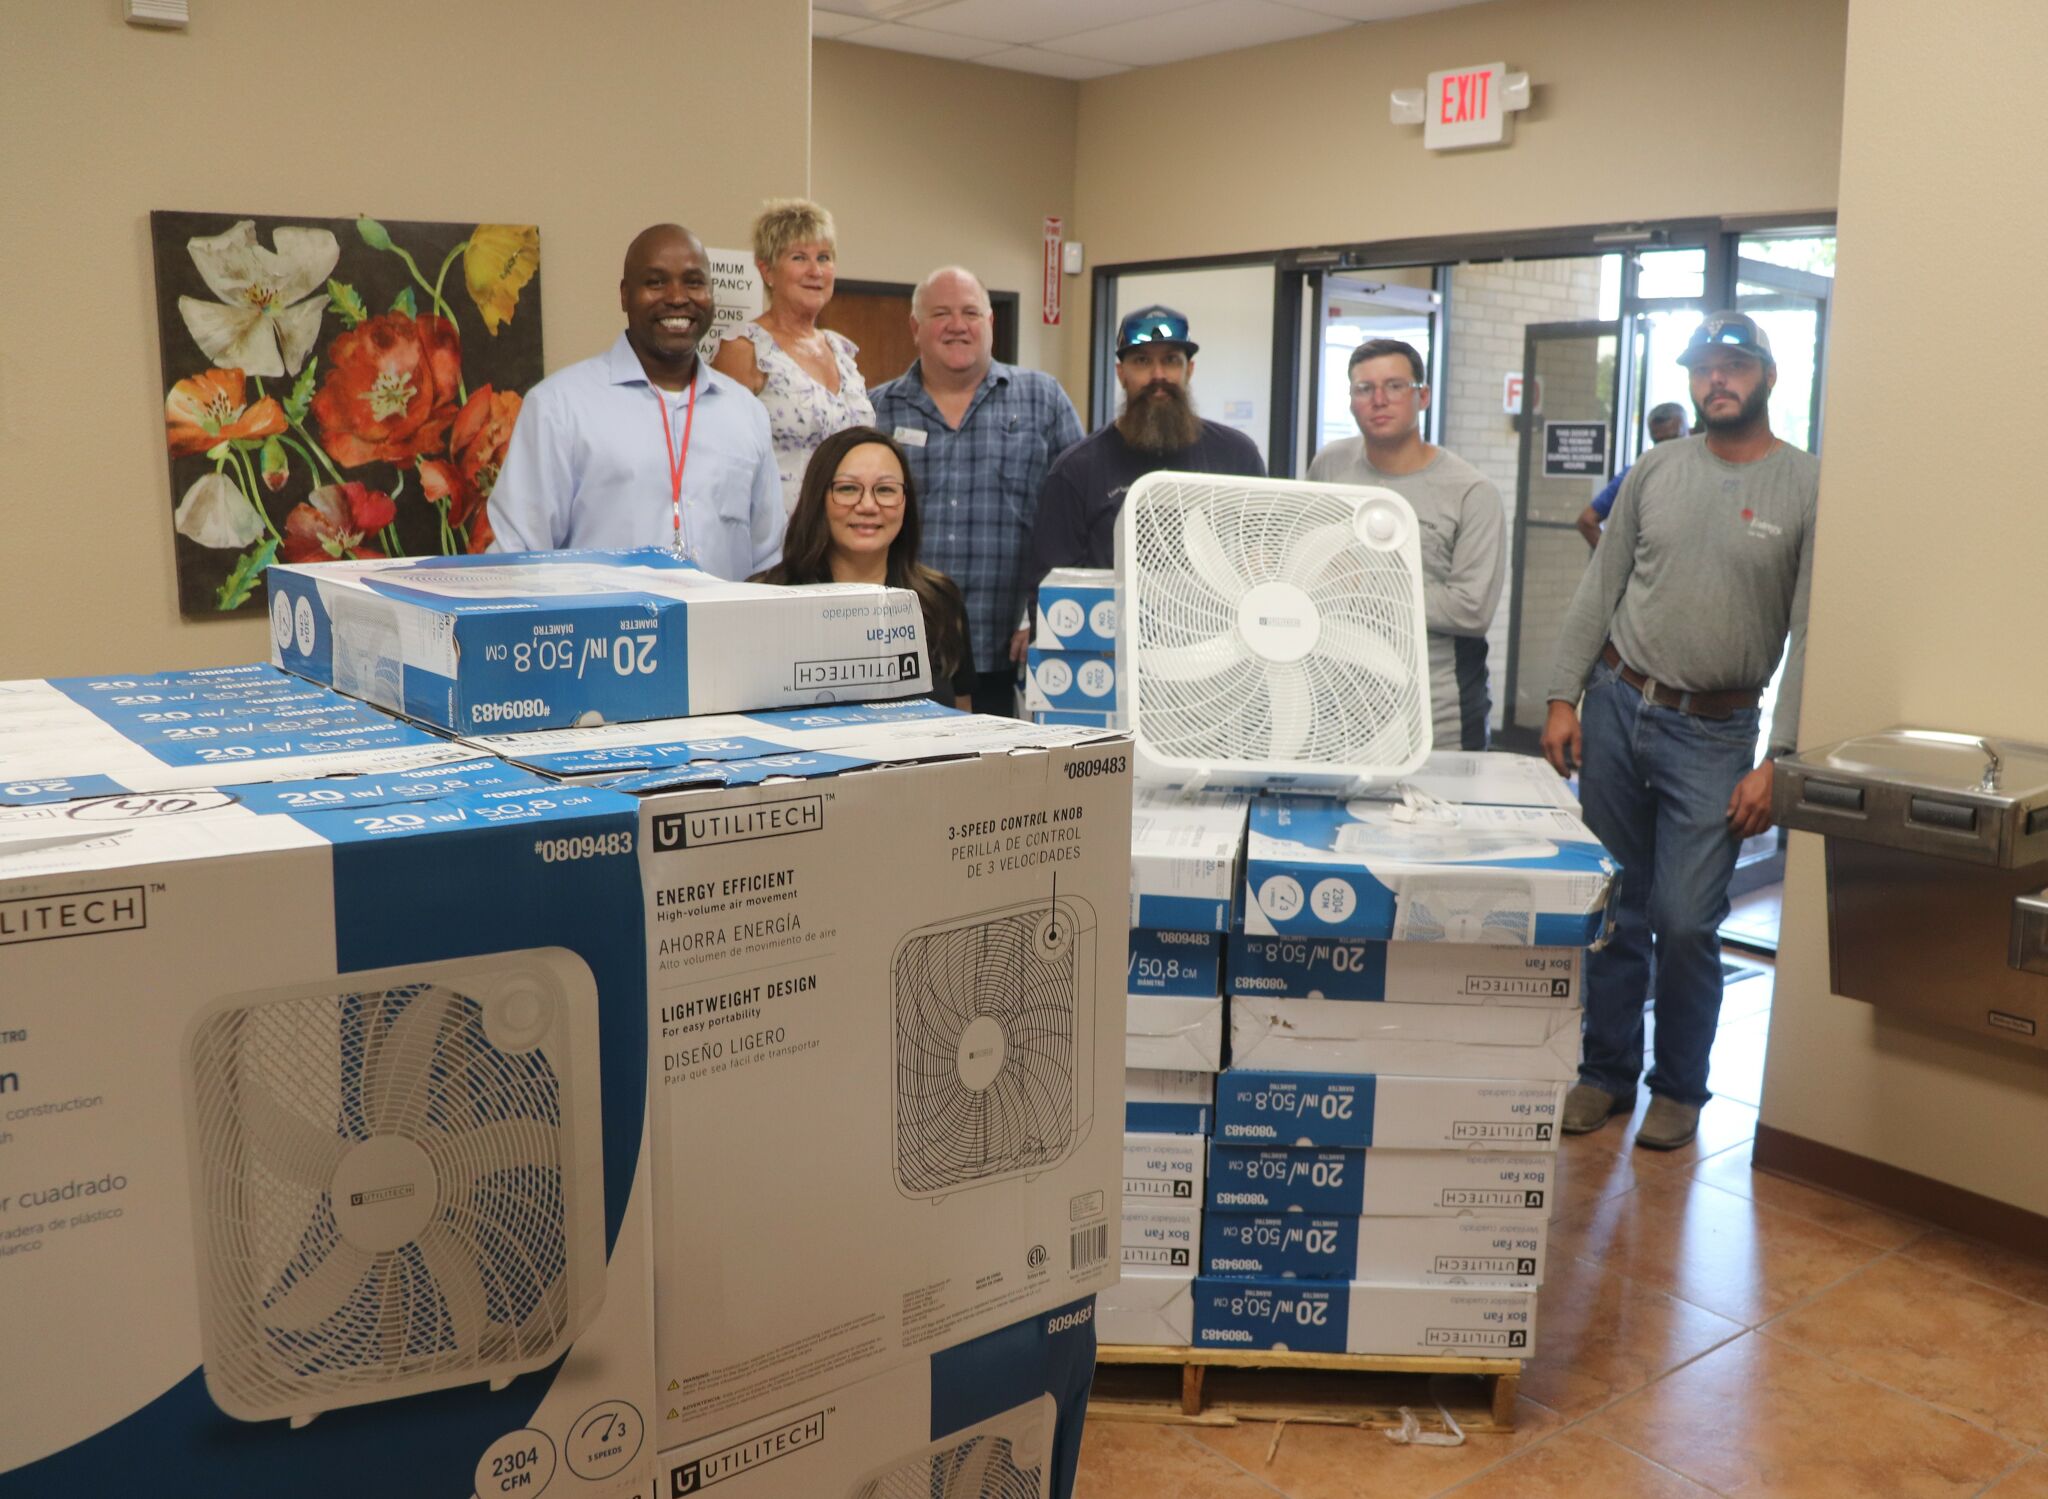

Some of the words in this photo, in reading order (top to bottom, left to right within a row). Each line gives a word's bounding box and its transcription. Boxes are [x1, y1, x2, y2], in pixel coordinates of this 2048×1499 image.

[1441, 71, 1493, 125] EXIT
[712, 262, 744, 275] IMUM
[711, 278, 752, 291] PANCY
[822, 607, 869, 619] cuadrado
[533, 624, 574, 636] DIÁMETRO
[620, 620, 658, 631] DIAMETER
[892, 625, 916, 640] Box
[867, 627, 891, 644] Fan
[485, 645, 507, 661] CM
[513, 637, 574, 673] 50,8
[612, 635, 658, 676] 20
[801, 663, 897, 683] UTILITECH
[88, 681, 137, 690] 20
[112, 694, 162, 704] 20
[137, 711, 192, 722] 20
[472, 698, 551, 723] #0809483
[162, 726, 219, 738] 20
[311, 723, 397, 737] #0809483
[196, 746, 256, 759] 20
[688, 741, 743, 753] 20
[401, 762, 494, 779] #0809483
[1064, 756, 1126, 779] #0809483
[4, 782, 75, 797] 20
[278, 789, 346, 806] 20
[475, 777, 502, 786] CM
[354, 814, 425, 831] 20
[474, 799, 558, 819] 50,8
[562, 795, 593, 807] CM
[691, 804, 817, 838] UTILITECH
[948, 820, 996, 840] 3-SPEED
[1001, 811, 1048, 831] CONTROL
[1053, 806, 1083, 822] KNOB
[535, 831, 632, 863] #0809483
[952, 840, 1000, 861] PERILLA
[1006, 836, 1020, 851] DE
[1026, 827, 1081, 847] CONTROL
[967, 864, 982, 879] DE
[987, 861, 995, 874] 3
[1000, 846, 1081, 872] VELOCIDADES
[656, 883, 716, 907] ENERGY
[722, 869, 795, 896] EFFICIENT
[657, 902, 726, 923] High-volume
[729, 899, 742, 910] air
[746, 889, 798, 907] movement
[1321, 891, 1330, 909] CFM
[1333, 888, 1344, 914] 2304
[0, 898, 134, 934] LITECH
[659, 928, 727, 956] AHORRA
[734, 913, 801, 942] ENERGÍA
[1156, 931, 1210, 946] #0809483
[659, 959, 680, 971] Alto
[684, 951, 727, 966] volumen
[730, 946, 742, 956] de
[745, 935, 802, 953] movimiento
[805, 931, 816, 942] de
[819, 928, 837, 939] aire
[1247, 943, 1262, 953] CM
[1265, 942, 1306, 963] 50,8
[1333, 947, 1366, 972] 20
[1525, 958, 1545, 971] Fan
[1550, 959, 1571, 971] Box
[1138, 958, 1180, 980] 50,8
[1182, 967, 1198, 979] CM
[1235, 976, 1288, 991] #0809483
[1470, 980, 1549, 993] UTILITECH
[661, 987, 761, 1023] LIGHTWEIGHT
[767, 975, 817, 999] DESIGN
[662, 1026, 680, 1038] For
[683, 1019, 705, 1034] easy
[708, 1007, 761, 1029] portability
[664, 1042, 723, 1071] DISEÑO
[730, 1027, 785, 1055] LIGERO
[664, 1073, 686, 1086] Para
[689, 1068, 708, 1081] que
[711, 1063, 727, 1074] sea
[730, 1056, 750, 1070] fácil
[754, 1051, 765, 1062] de
[768, 1039, 820, 1058] transportar
[1237, 1092, 1252, 1102] CM
[1255, 1089, 1296, 1111] 50,8
[6, 1094, 103, 1122] construction
[1321, 1094, 1353, 1120] 20
[1511, 1104, 1531, 1116] Fan
[1535, 1104, 1556, 1116] Box
[1225, 1124, 1277, 1138] #0809483
[1457, 1126, 1534, 1138] UTILITECH
[1147, 1160, 1167, 1172] Fan
[1171, 1162, 1193, 1173] Box
[1228, 1160, 1243, 1171] CM
[1247, 1157, 1287, 1180] 50,8
[1312, 1162, 1344, 1188] 20
[1500, 1171, 1520, 1183] Fan
[1523, 1172, 1545, 1183] Box
[19, 1174, 127, 1209] cuadrado
[1217, 1192, 1269, 1206] #0809483
[1446, 1192, 1523, 1204] UTILITECH
[0, 1222, 44, 1241] radera
[48, 1218, 66, 1231] de
[70, 1207, 124, 1229] plástico
[1223, 1226, 1238, 1237] CM
[1144, 1229, 1164, 1241] Fan
[1168, 1230, 1190, 1241] Box
[1241, 1224, 1281, 1246] 50,8
[1305, 1229, 1338, 1254] 20
[0, 1239, 42, 1257] lanco
[1492, 1239, 1512, 1251] Fan
[1516, 1239, 1537, 1251] Box
[1211, 1258, 1263, 1271] #0809483
[1439, 1260, 1515, 1272] UTILITECH
[1213, 1297, 1229, 1307] CM
[1231, 1296, 1271, 1317] 50,8
[1296, 1301, 1329, 1326] 20
[1483, 1311, 1503, 1323] Fan
[1507, 1311, 1528, 1322] Box
[1202, 1329, 1253, 1342] #0809483
[1430, 1331, 1506, 1344] UTILITECH
[617, 1422, 626, 1438] 3
[593, 1446, 622, 1461] SPEEDS
[705, 1420, 818, 1479] UTILITECH
[492, 1447, 539, 1478] 2304
[501, 1471, 531, 1492] CFM
